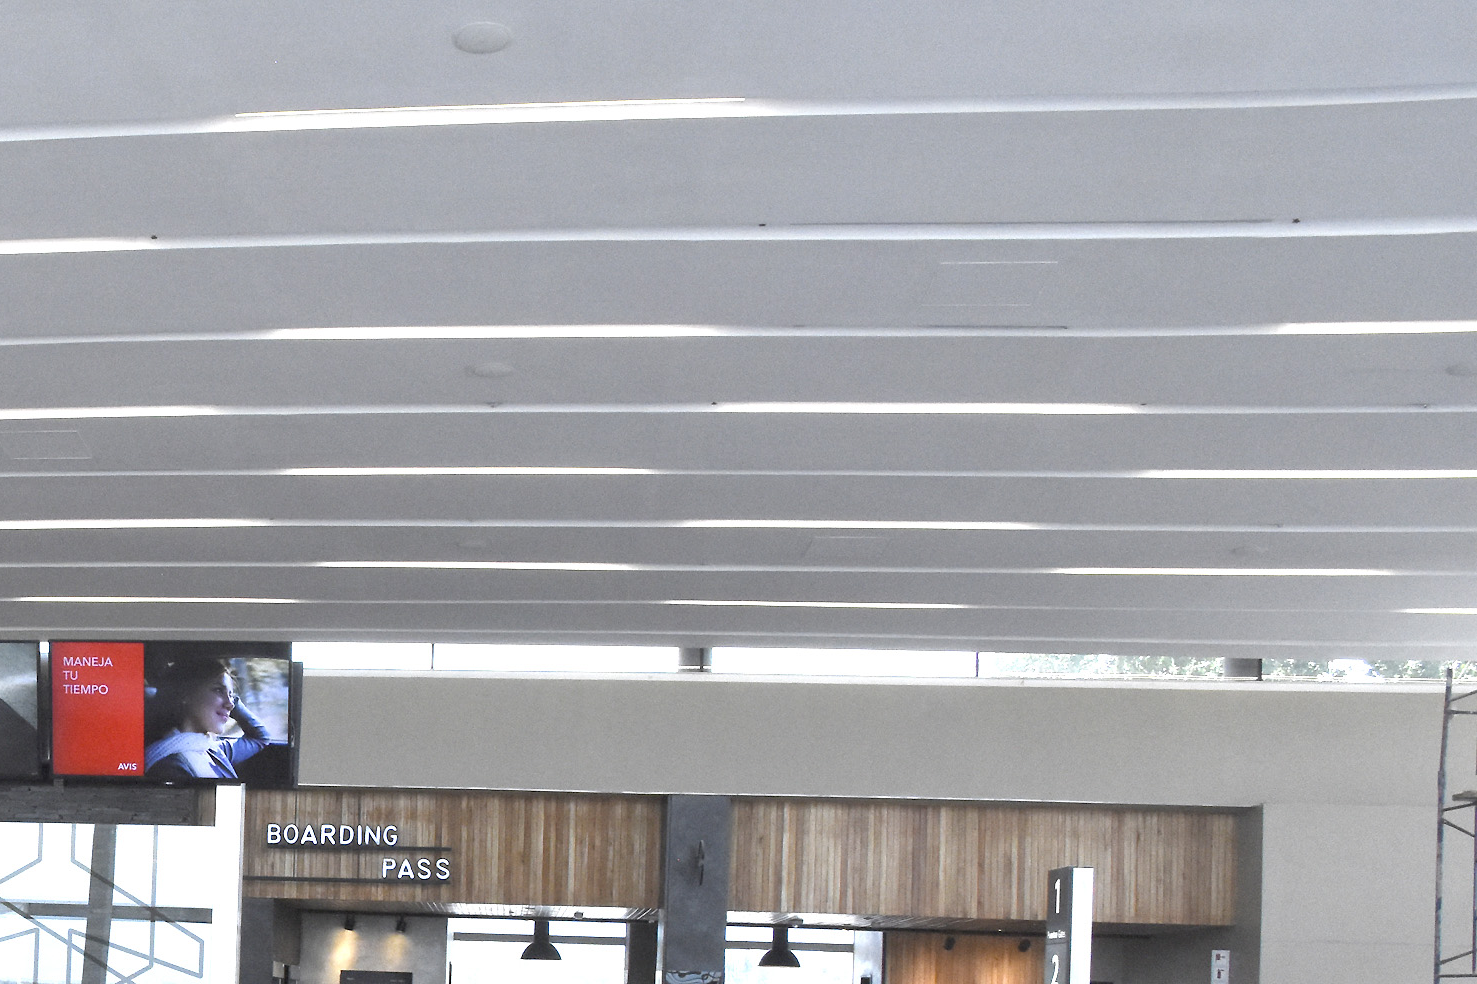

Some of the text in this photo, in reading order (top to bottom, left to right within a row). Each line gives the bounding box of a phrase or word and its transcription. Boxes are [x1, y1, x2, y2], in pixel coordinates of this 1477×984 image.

[63, 657, 113, 667] MANEJA
[63, 670, 78, 681] TU
[63, 684, 109, 695] TIEMPO
[117, 763, 137, 771] AVIS
[266, 823, 399, 846] BOARDING
[381, 858, 451, 880] PASS
[1054, 878, 1061, 914] 1
